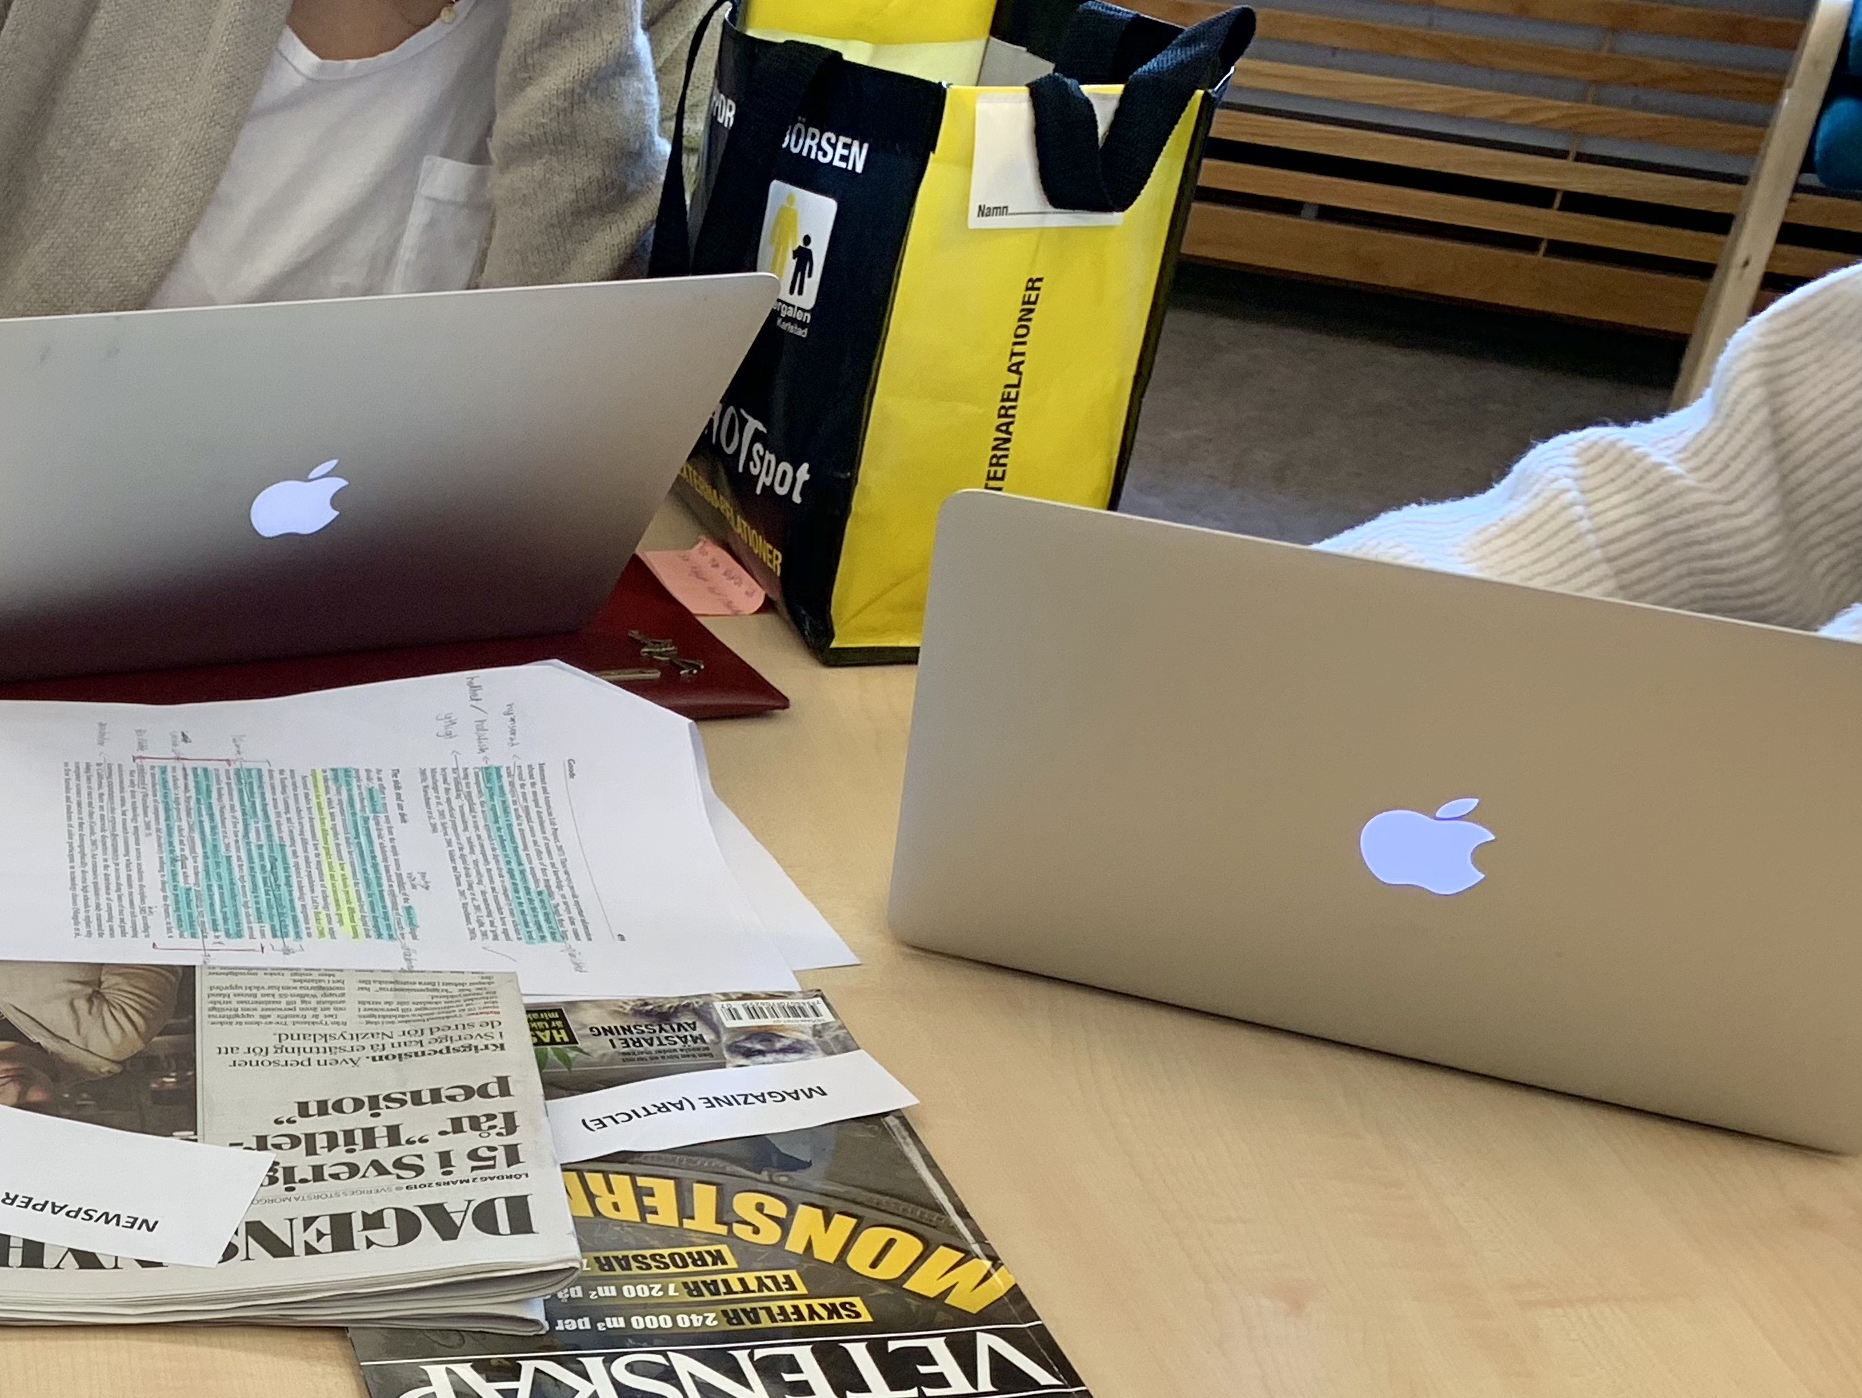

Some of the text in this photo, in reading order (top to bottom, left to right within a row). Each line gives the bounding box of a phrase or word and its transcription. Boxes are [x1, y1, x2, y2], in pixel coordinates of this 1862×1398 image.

[977, 203, 1008, 218] Namn
[984, 275, 1045, 492] TERNARELATIONER
[273, 1020, 502, 1043] de stred för Nazityskland.
[588, 1021, 697, 1037] AVLYSSNING
[391, 1039, 423, 1050] kan
[428, 1033, 494, 1045] Sverige
[608, 1034, 707, 1049] MÄSTARE I
[216, 1047, 239, 1055] att
[229, 1043, 506, 1068] Krigspension. Även personer
[243, 1047, 269, 1057] för
[273, 1044, 365, 1056] ersättning
[370, 1043, 385, 1052] få
[581, 1085, 828, 1132] MAGAZINE (ARTICLE)
[438, 1111, 520, 1139] får
[262, 1143, 523, 1193] 15 i Sverig
[435, 1179, 470, 1187] MARS
[479, 1173, 529, 1182] LÖRDAG
[293, 1191, 342, 1201] STÖRSTA
[342, 1186, 394, 1197] SVERIGES
[251, 1196, 292, 1205] MORGO
[1, 1191, 159, 1233] NEWSPAPER
[595, 1248, 729, 1273] KROSSAR
[622, 1282, 664, 1298] 200
[669, 1282, 679, 1295] 7
[686, 1274, 795, 1298] FLYTTAR
[629, 1313, 674, 1329] 000
[677, 1311, 719, 1327] 240
[720, 1300, 863, 1328] SKYFFLAR
[554, 1315, 592, 1332] per
